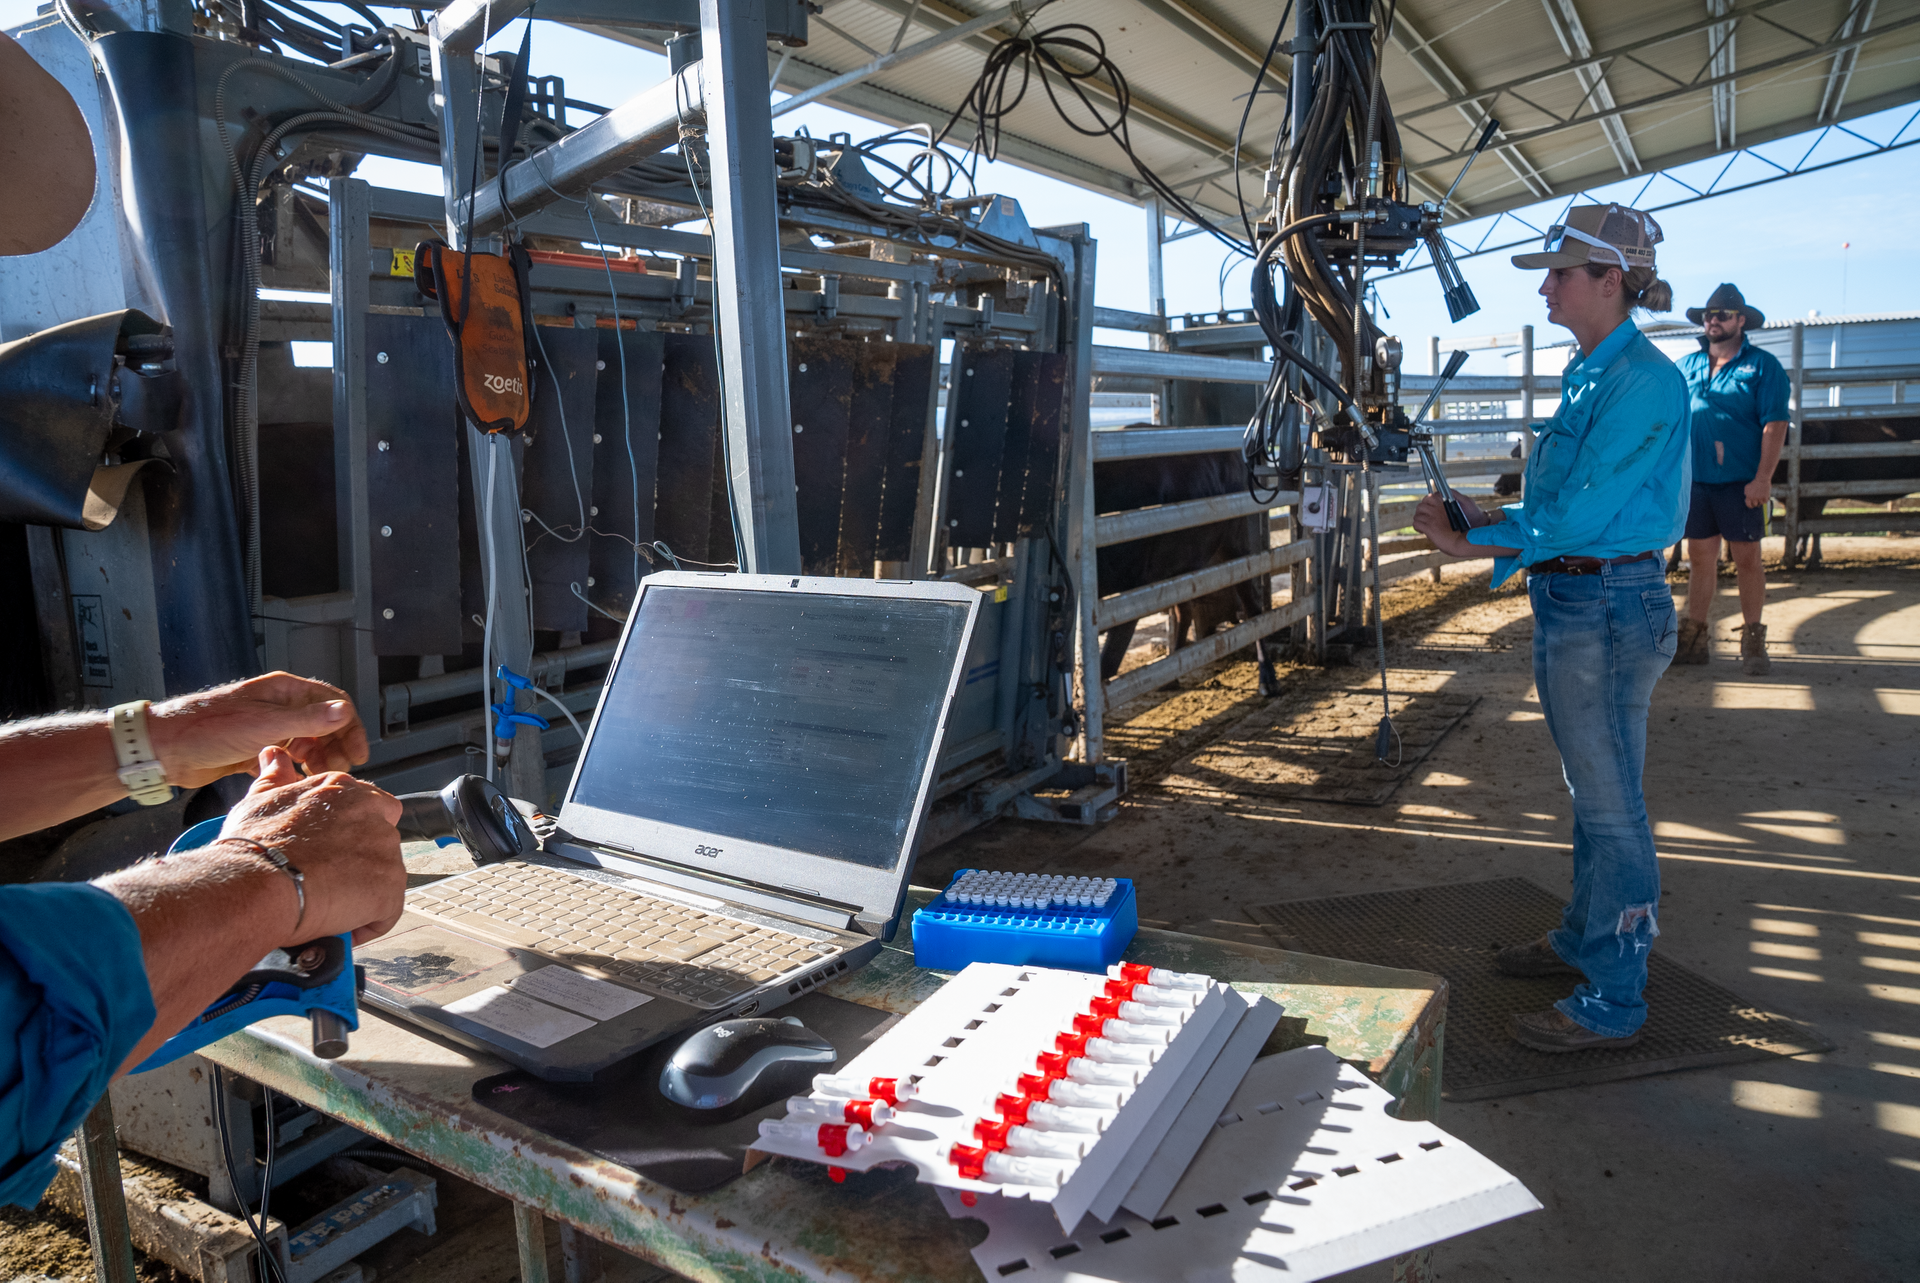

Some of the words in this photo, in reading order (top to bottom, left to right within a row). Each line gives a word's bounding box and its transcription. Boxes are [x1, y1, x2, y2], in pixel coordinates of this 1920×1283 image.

[484, 374, 523, 396] zoetis
[694, 844, 724, 858] acer
[712, 1026, 735, 1038] logi
